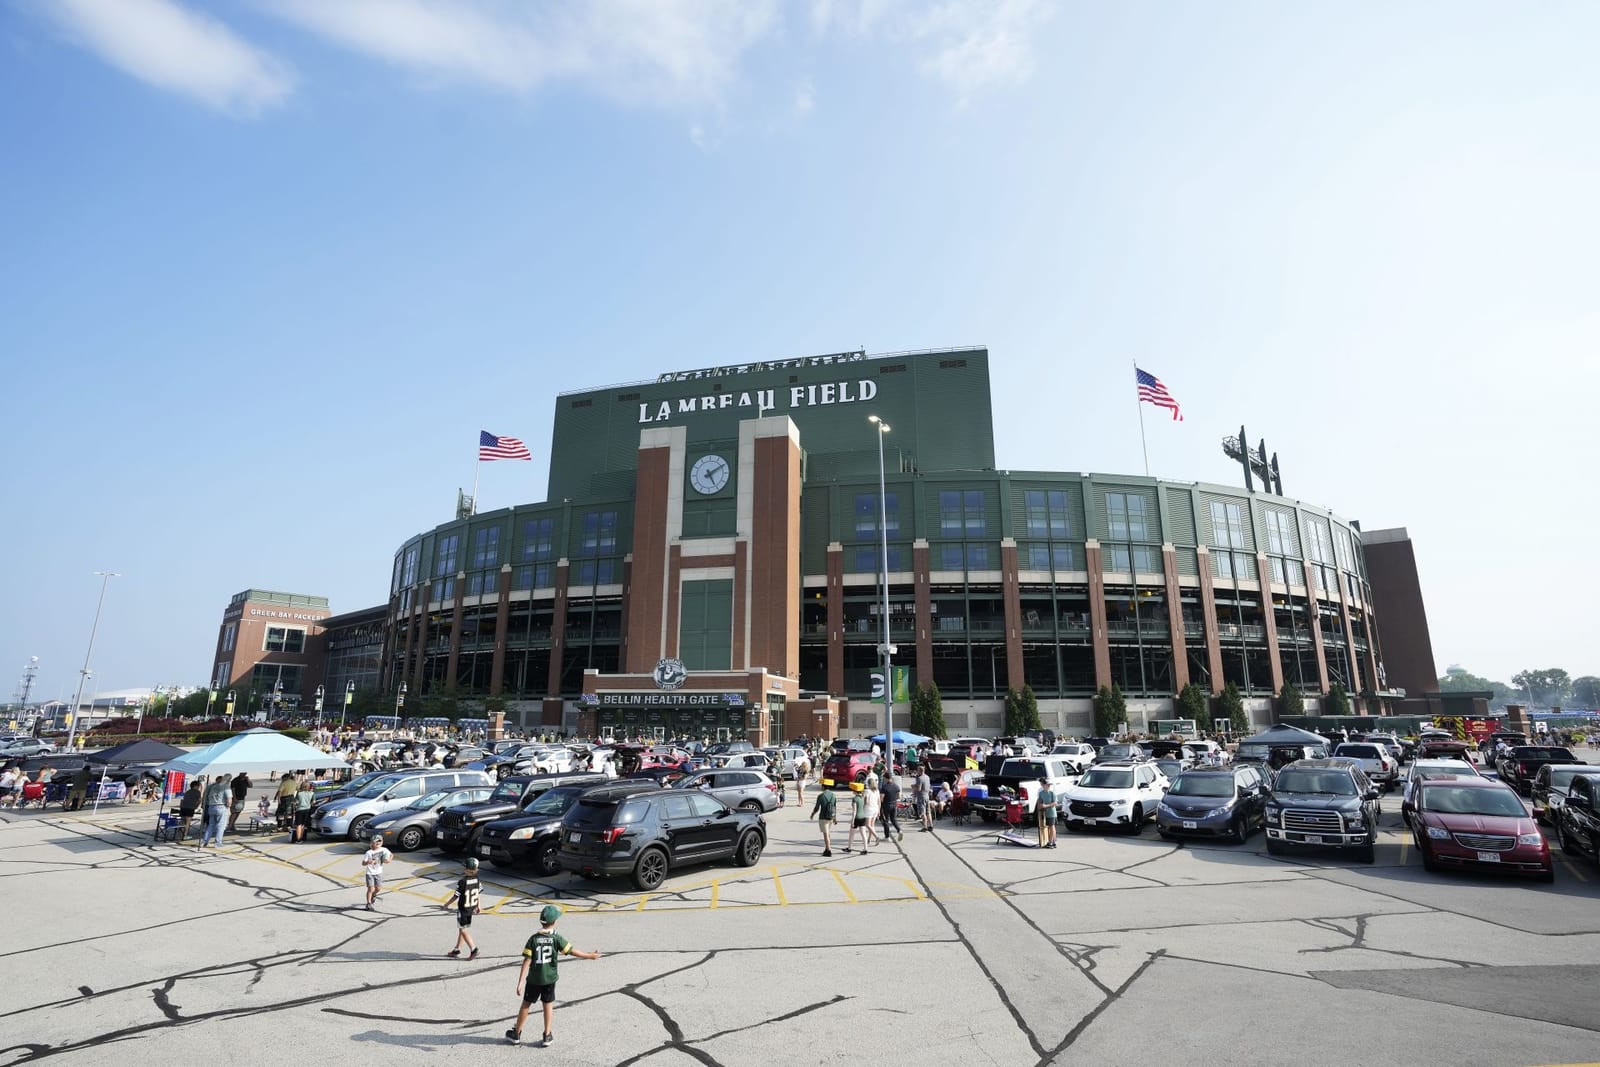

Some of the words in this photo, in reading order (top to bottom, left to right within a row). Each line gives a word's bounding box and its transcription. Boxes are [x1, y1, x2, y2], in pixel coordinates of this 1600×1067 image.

[789, 379, 878, 408] FIELD
[250, 608, 276, 618] GREEN
[278, 612, 292, 620] BAY
[603, 695, 642, 705] BELLIN
[644, 695, 686, 705] HEALTH
[689, 695, 719, 705] GATE
[464, 889, 479, 908] 12
[535, 945, 553, 965] 12
